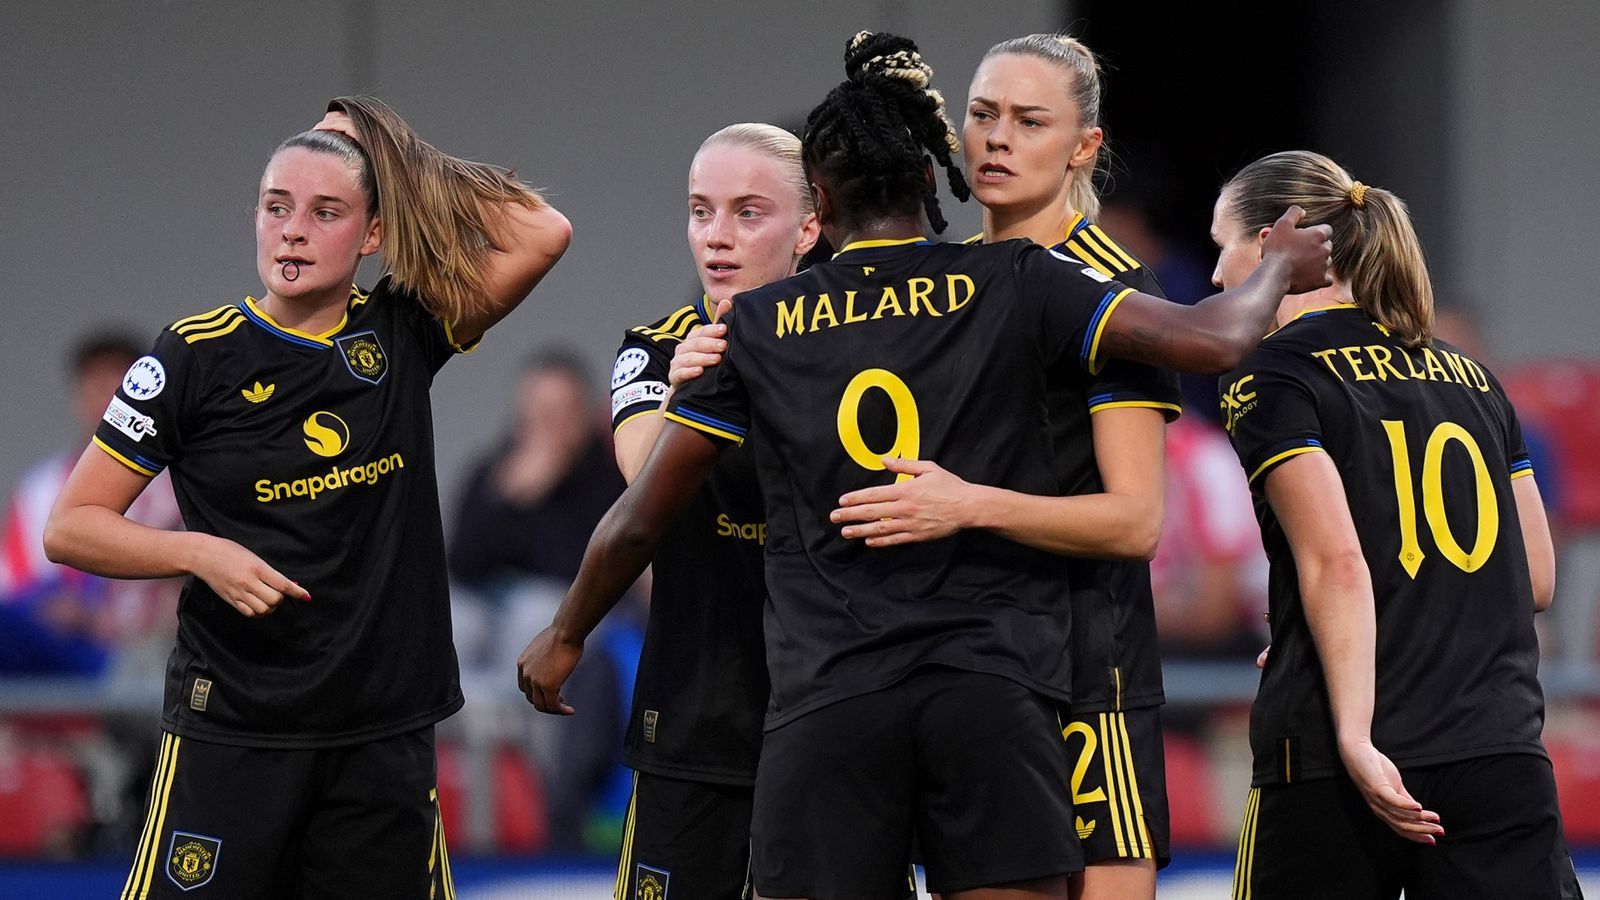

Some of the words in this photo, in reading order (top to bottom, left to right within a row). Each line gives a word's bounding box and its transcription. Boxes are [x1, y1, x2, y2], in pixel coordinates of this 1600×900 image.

[775, 274, 976, 339] MALARD
[1310, 344, 1490, 393] TERLAND
[127, 415, 145, 434] 10
[837, 368, 920, 521] 9
[255, 453, 404, 502] Snapdragon
[1380, 419, 1499, 580] 10
[717, 513, 767, 545] Snap
[1062, 721, 1107, 805] 2
